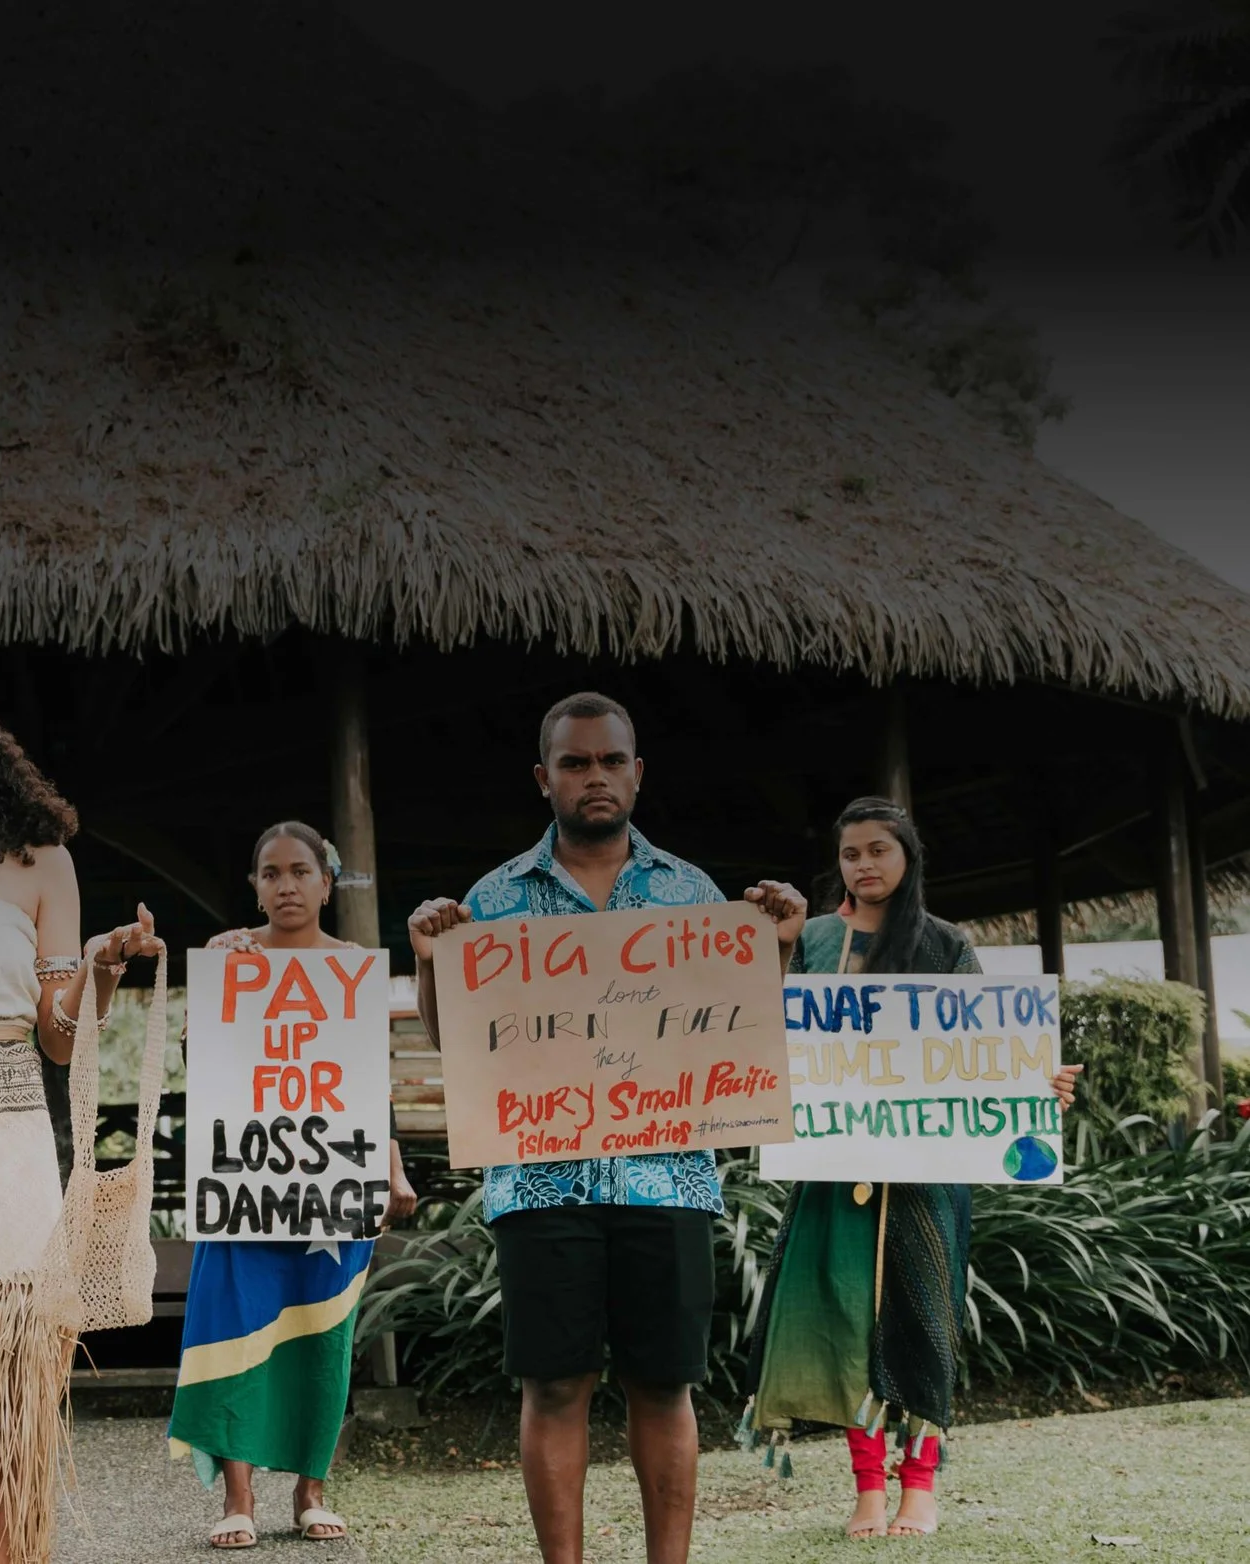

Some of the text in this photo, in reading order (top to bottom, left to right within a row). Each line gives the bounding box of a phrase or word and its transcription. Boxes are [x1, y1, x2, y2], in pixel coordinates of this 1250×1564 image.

[620, 917, 756, 974] Cities
[221, 952, 376, 1023] PAY
[489, 1002, 758, 1052] BURN FUEL
[593, 1046, 643, 1080] they
[922, 1033, 1054, 1085] DUIM
[253, 1061, 345, 1112] FOR
[608, 1071, 693, 1121] Small
[702, 1060, 778, 1106] Pacific
[517, 1120, 692, 1159] island countries
[195, 1176, 390, 1240] DAMAGE
